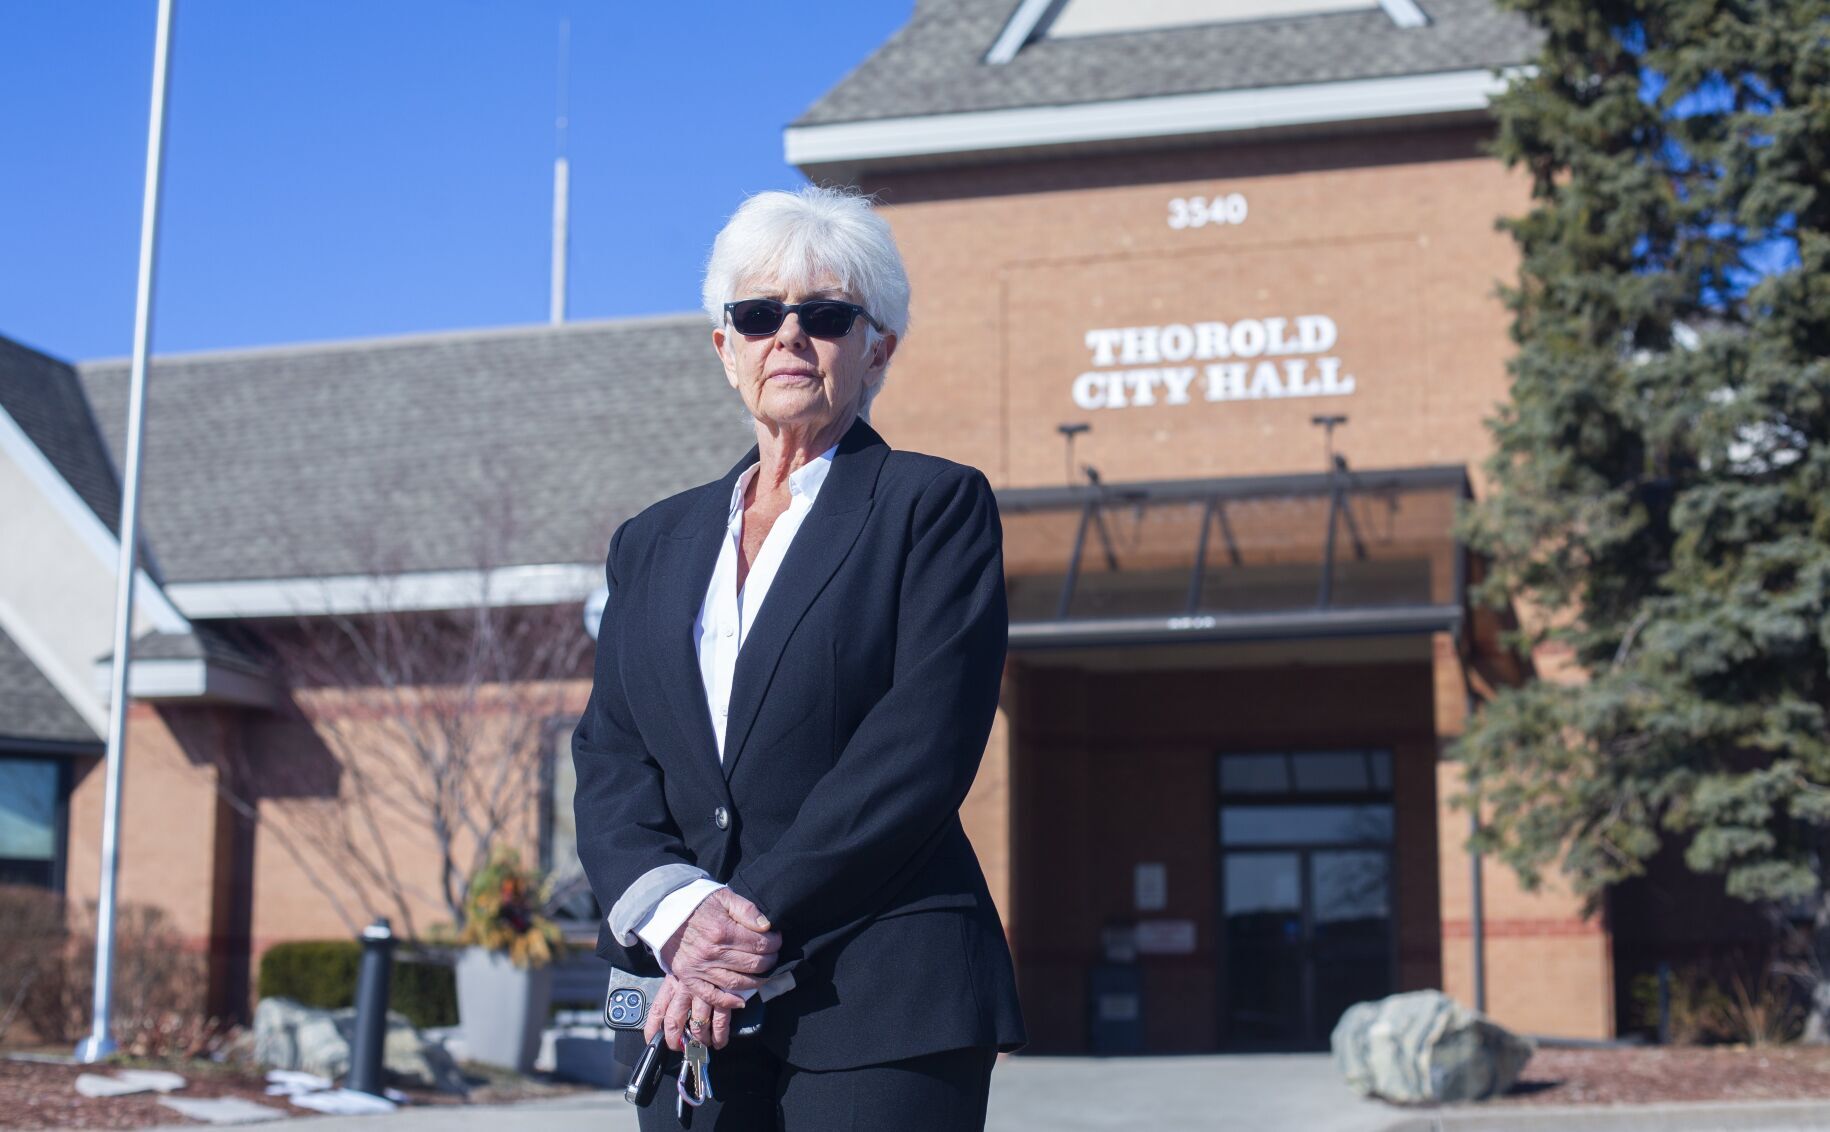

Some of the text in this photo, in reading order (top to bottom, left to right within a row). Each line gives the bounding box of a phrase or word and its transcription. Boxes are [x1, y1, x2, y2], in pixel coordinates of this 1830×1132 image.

[1167, 193, 1248, 230] 3540
[1085, 315, 1338, 366] THOROLD
[1072, 357, 1355, 410] CITY HALL
